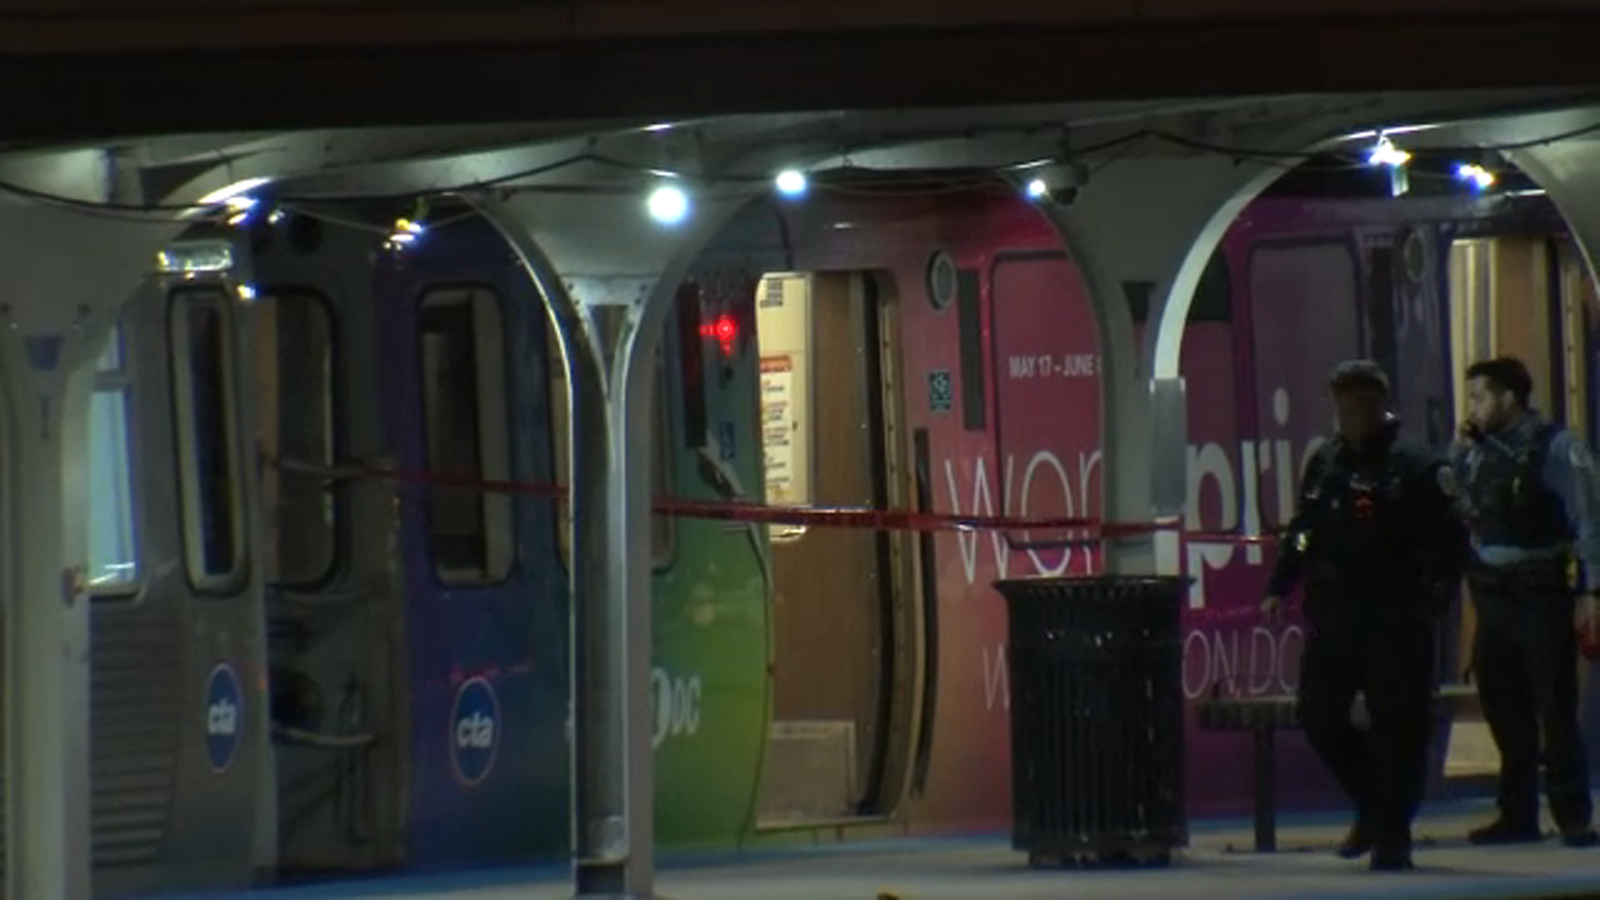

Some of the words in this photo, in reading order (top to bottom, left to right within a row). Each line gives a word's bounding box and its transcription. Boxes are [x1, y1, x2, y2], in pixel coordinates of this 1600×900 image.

[1009, 354, 1035, 378] MAY
[1037, 354, 1052, 376] 17
[1063, 353, 1094, 376] JUNE
[945, 450, 1102, 584] wor
[208, 697, 237, 735] cta
[456, 711, 494, 748] cta
